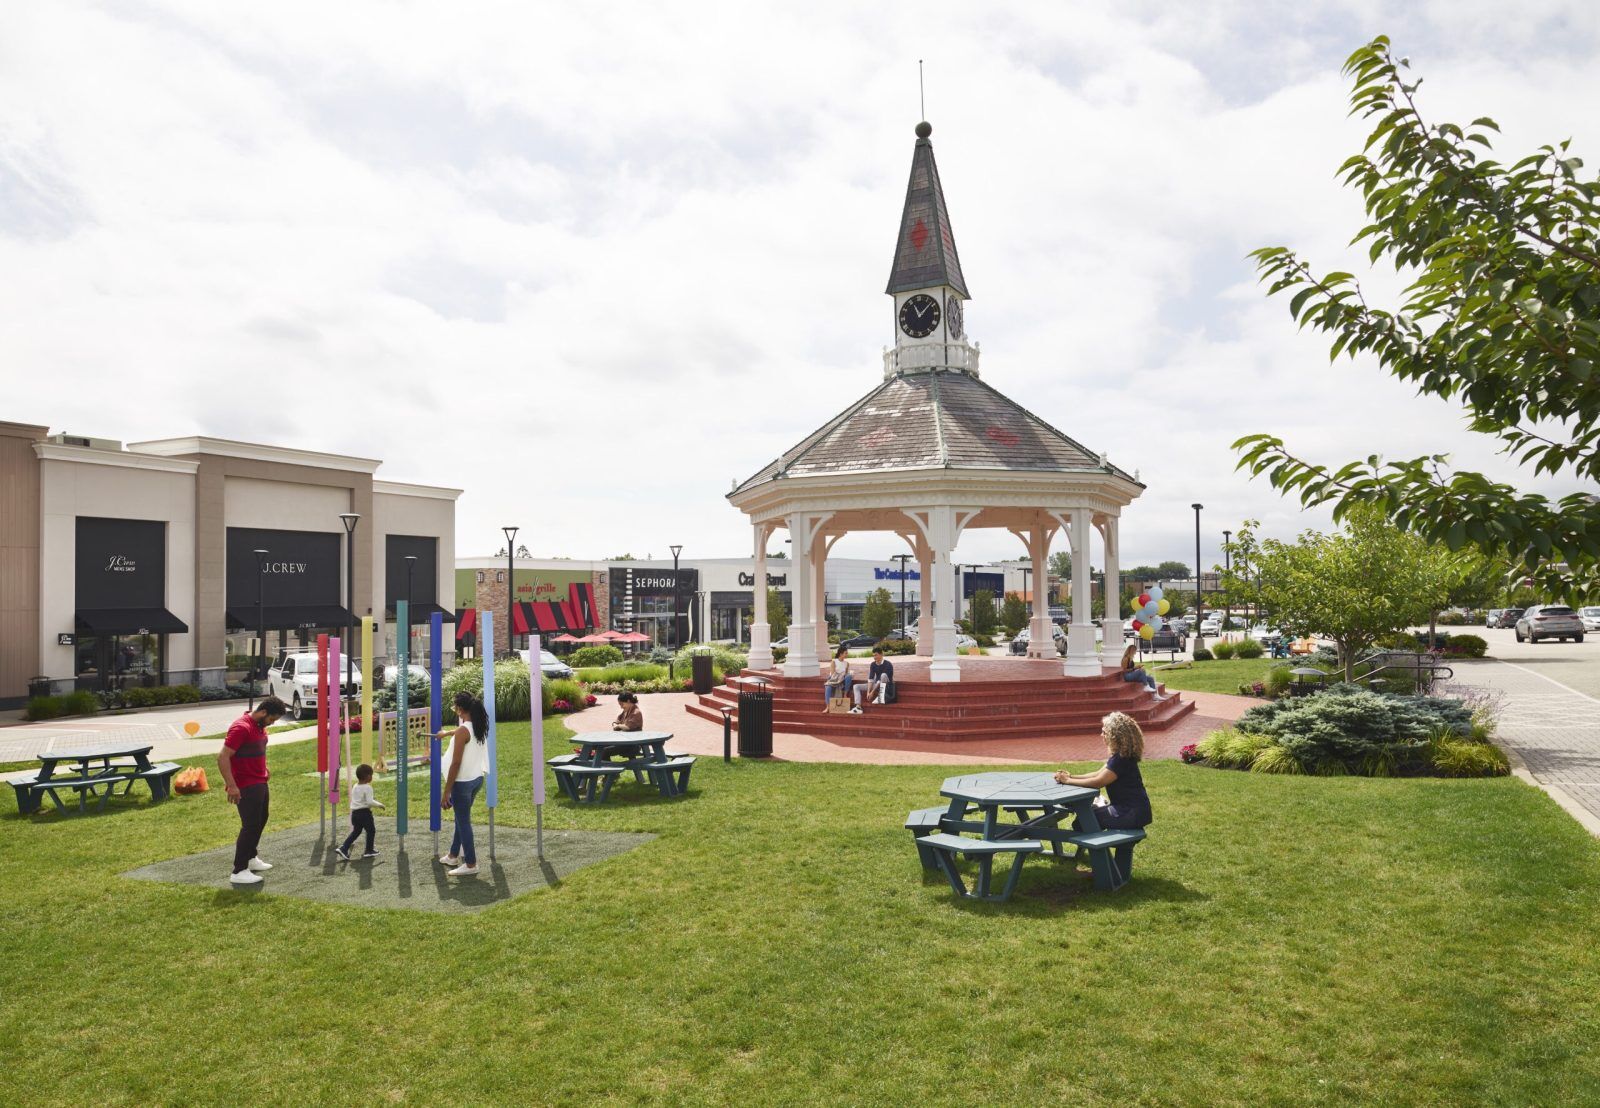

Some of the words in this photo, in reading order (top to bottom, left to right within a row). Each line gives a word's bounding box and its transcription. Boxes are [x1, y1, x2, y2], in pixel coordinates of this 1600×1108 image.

[262, 562, 307, 574] J.CREW
[885, 568, 909, 580] Contaier
[909, 569, 921, 580] Stor
[636, 577, 676, 588] SEPHORA
[738, 571, 754, 586] Cra
[517, 583, 533, 593] asia
[535, 583, 556, 596] grille
